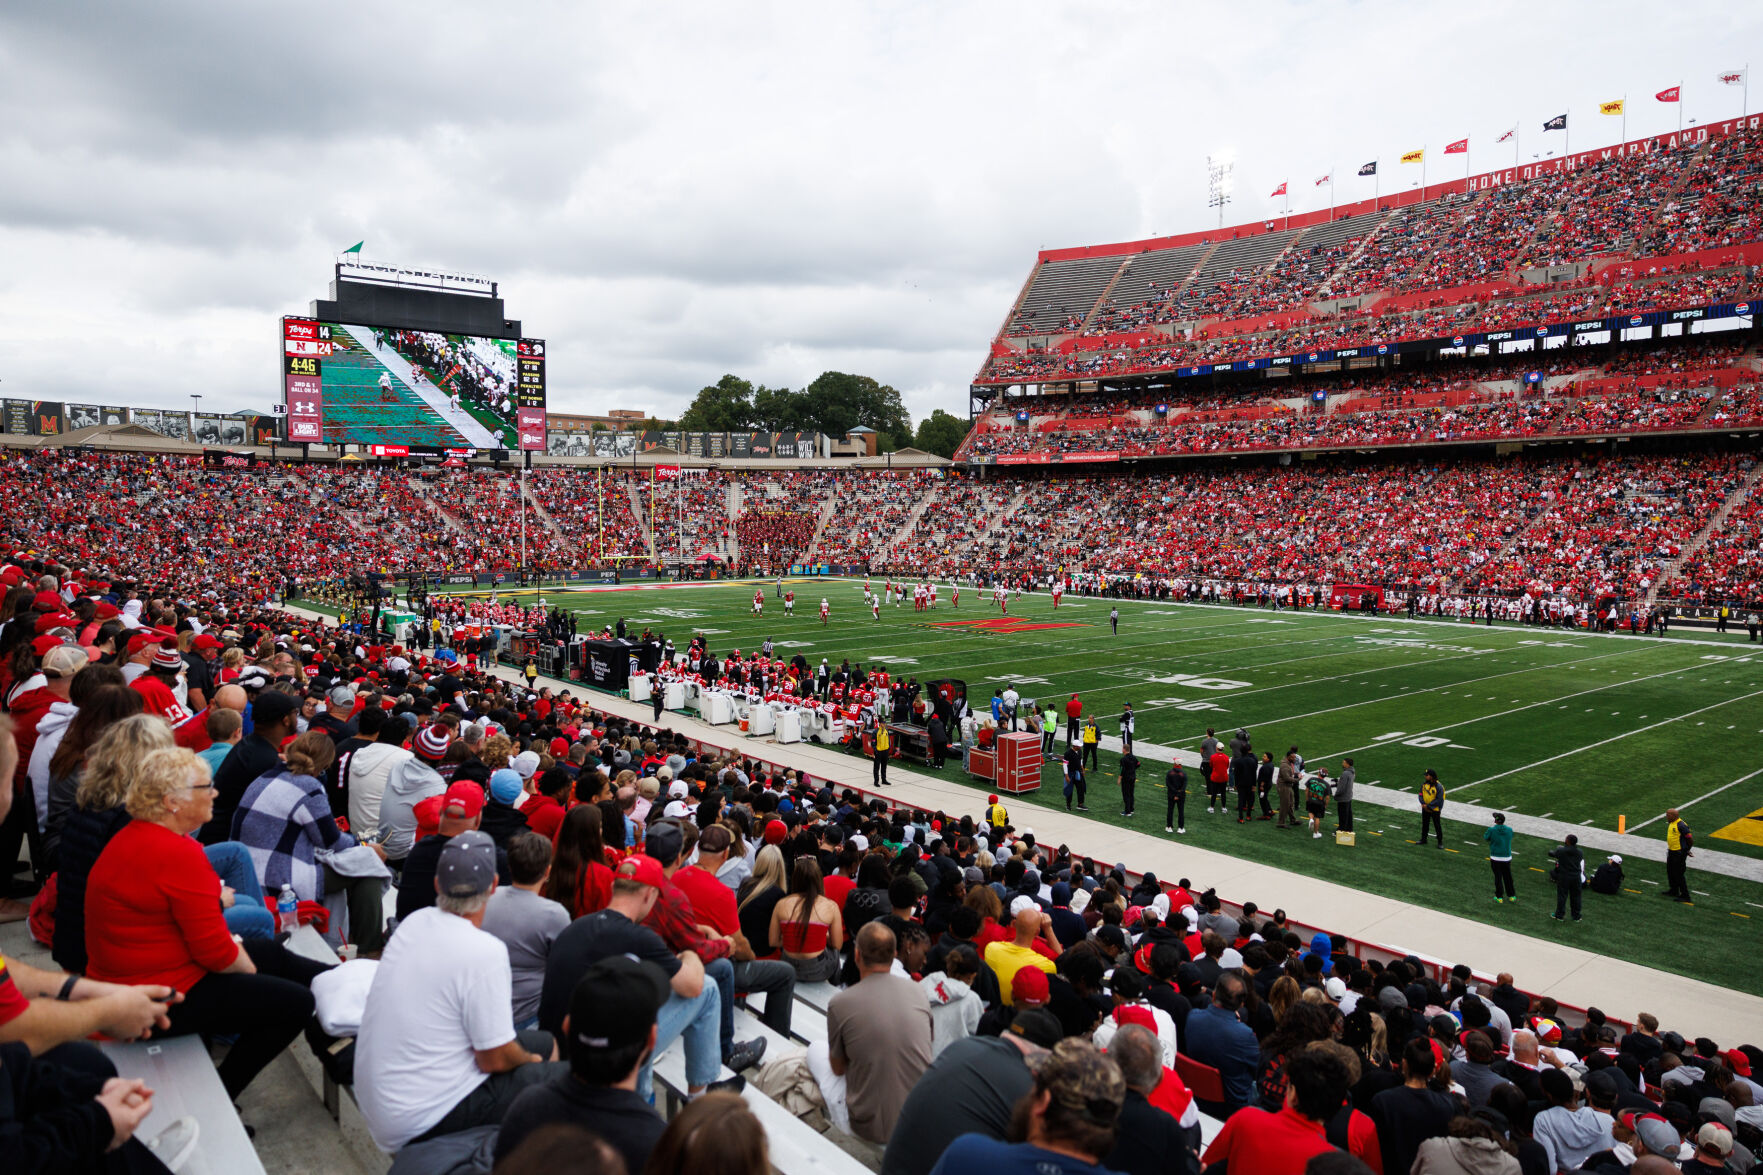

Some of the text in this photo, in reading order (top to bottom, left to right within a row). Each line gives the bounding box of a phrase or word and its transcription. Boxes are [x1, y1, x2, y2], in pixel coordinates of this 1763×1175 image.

[1469, 171, 1512, 191] HOME
[1672, 310, 1703, 320] PEPSI
[288, 325, 312, 336] Terps
[1575, 321, 1602, 331] PEPSI
[319, 326, 330, 339] 14
[1488, 332, 1512, 342] PEPSI
[296, 341, 306, 352] N
[318, 342, 332, 355] 24
[1337, 349, 1358, 358] PEPSI
[291, 358, 316, 372] 4:46
[1273, 357, 1291, 365] PEPSI
[1214, 364, 1231, 372] PEPSI
[40, 414, 58, 432] M
[798, 444, 814, 452] WILL
[798, 451, 813, 459] WIN
[222, 456, 249, 467] Terps
[449, 576, 472, 584] PEPSI
[165, 704, 184, 721] 13
[1371, 731, 1451, 748] 10
[338, 751, 351, 788] 1
